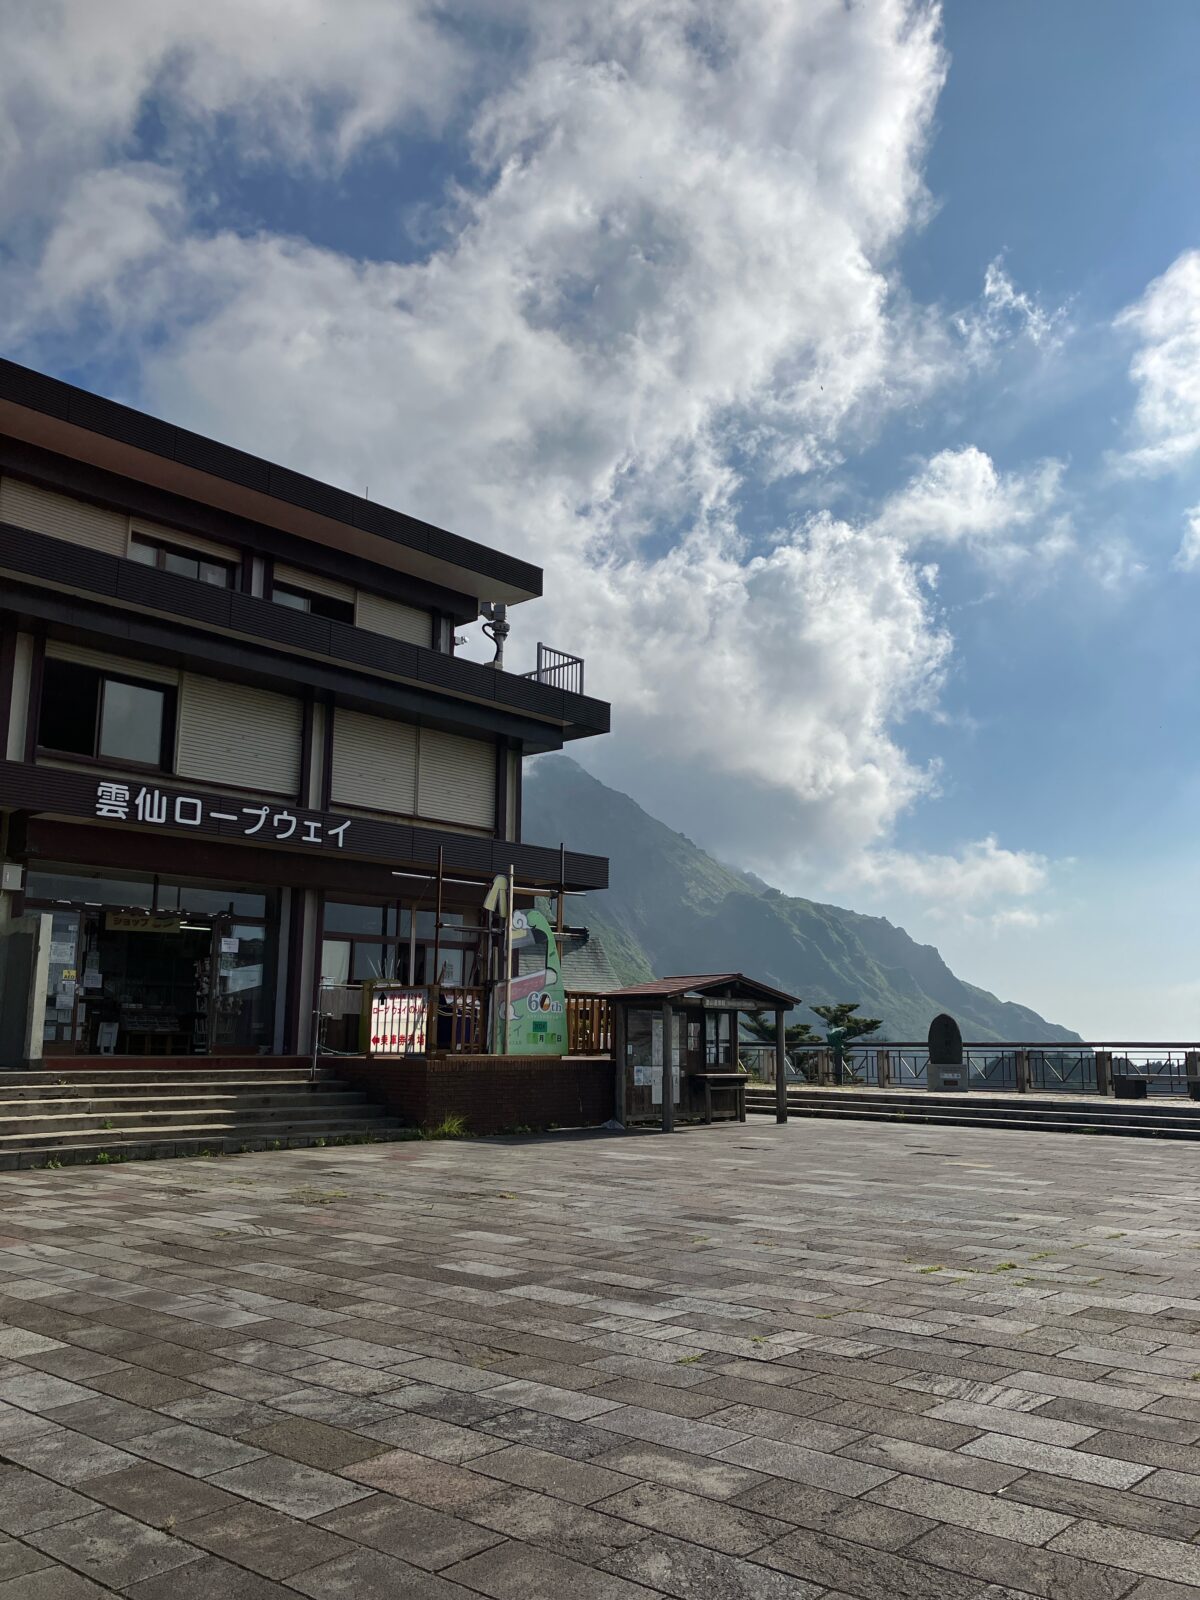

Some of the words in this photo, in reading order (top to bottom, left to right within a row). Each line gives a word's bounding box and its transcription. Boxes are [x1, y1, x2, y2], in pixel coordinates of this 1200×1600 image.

[95, 781, 351, 848] 雲仙ロープウェイ
[527, 992, 562, 1013] 60th
